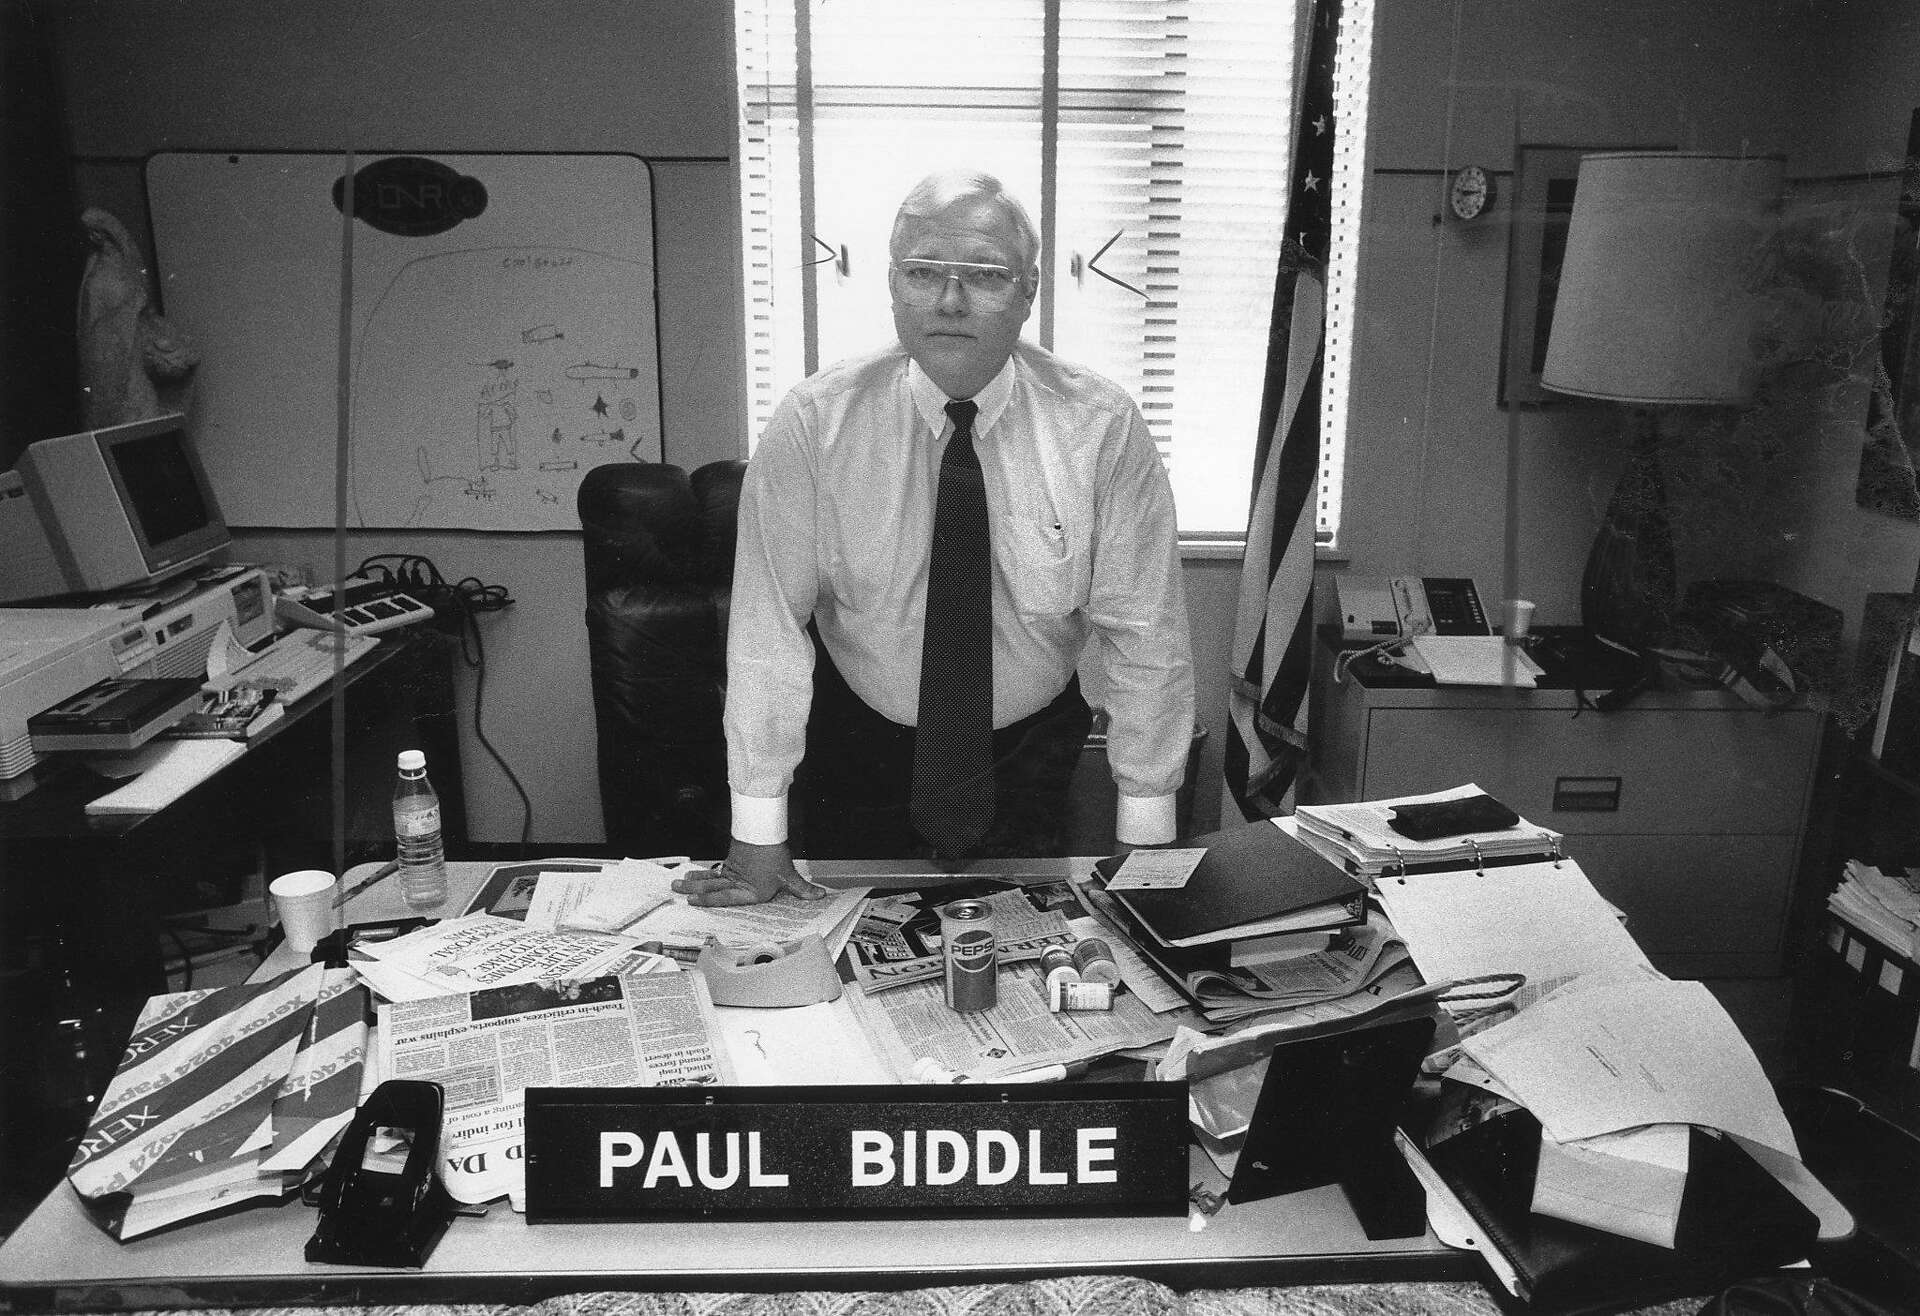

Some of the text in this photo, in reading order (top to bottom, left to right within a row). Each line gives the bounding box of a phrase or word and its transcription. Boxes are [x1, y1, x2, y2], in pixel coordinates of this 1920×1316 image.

[469, 1016, 521, 1031] supports,
[420, 1026, 468, 1041] explains
[395, 1037, 417, 1046] war
[493, 1120, 513, 1130] for
[600, 1127, 1118, 1191] PAUL BIDDLE
